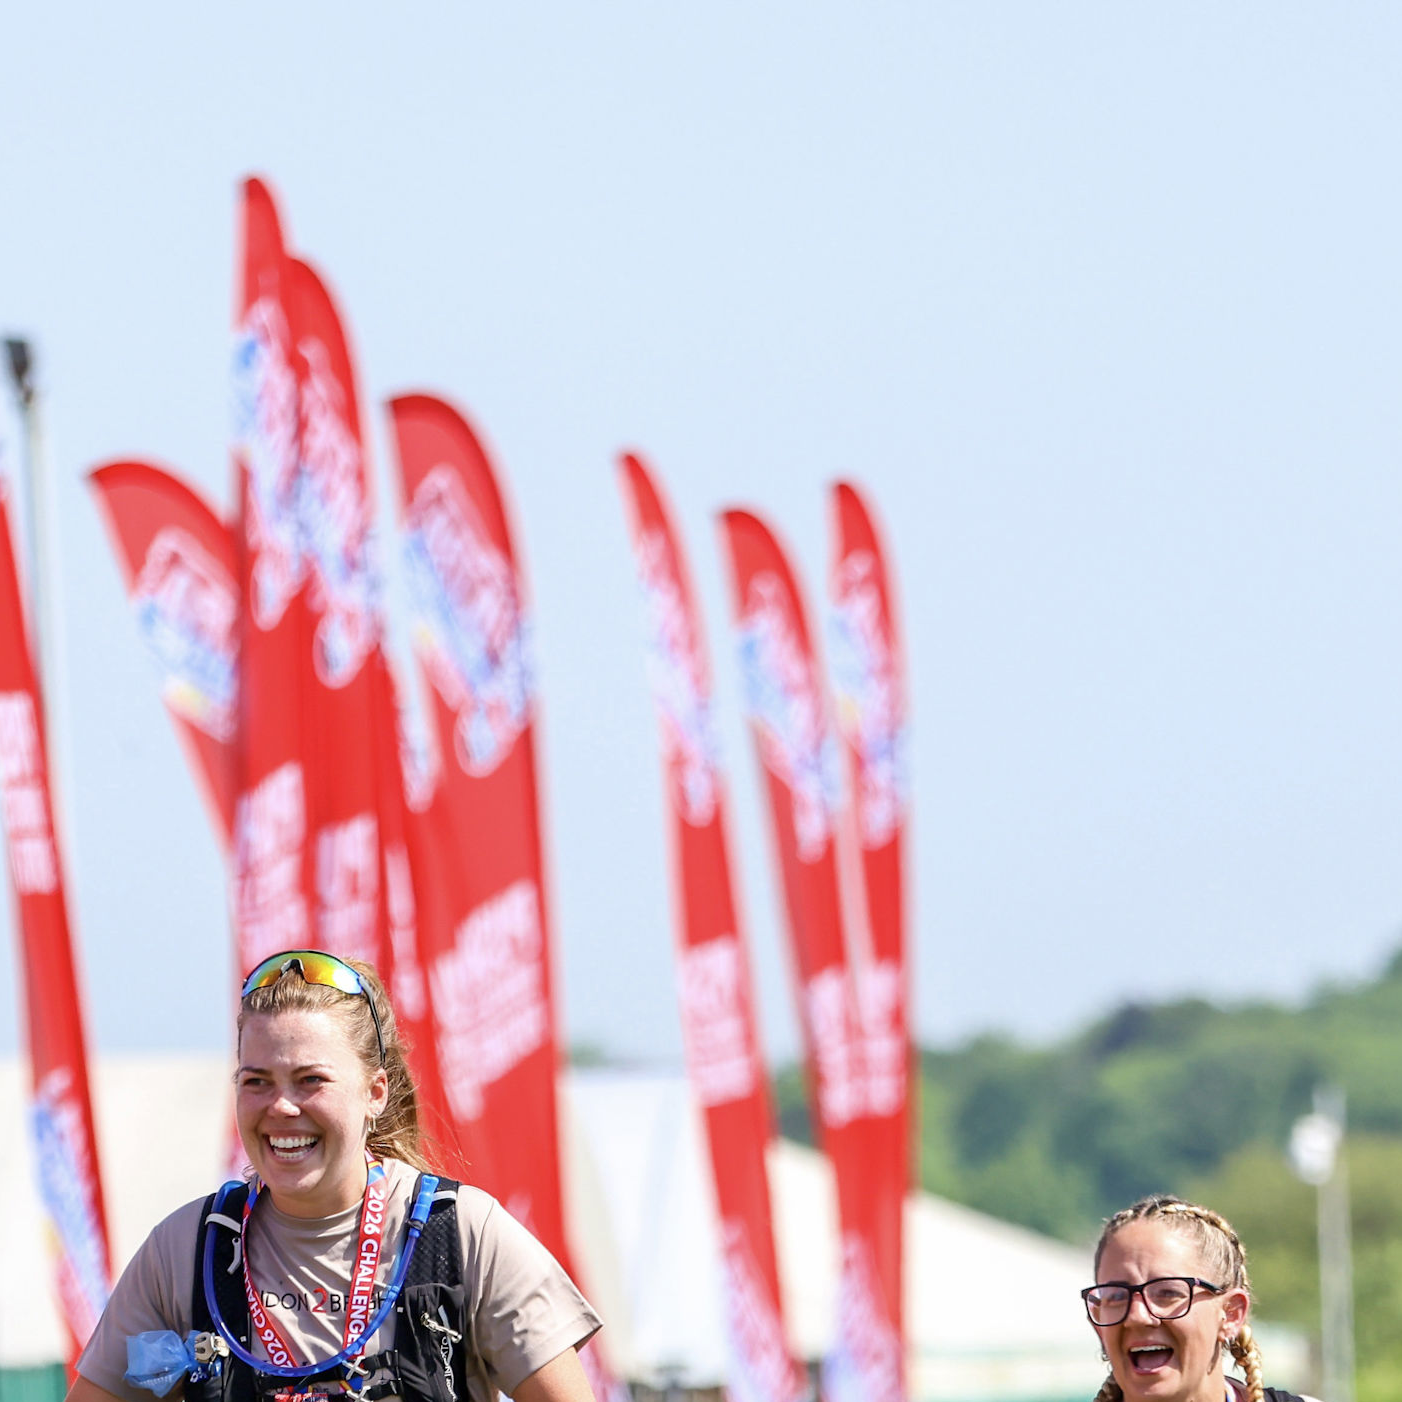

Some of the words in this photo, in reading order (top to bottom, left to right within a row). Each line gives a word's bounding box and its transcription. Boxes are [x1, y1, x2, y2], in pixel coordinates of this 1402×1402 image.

[363, 1187, 385, 1235] 2026
[312, 1288, 329, 1313] 2
[261, 1329, 294, 1369] 2026
